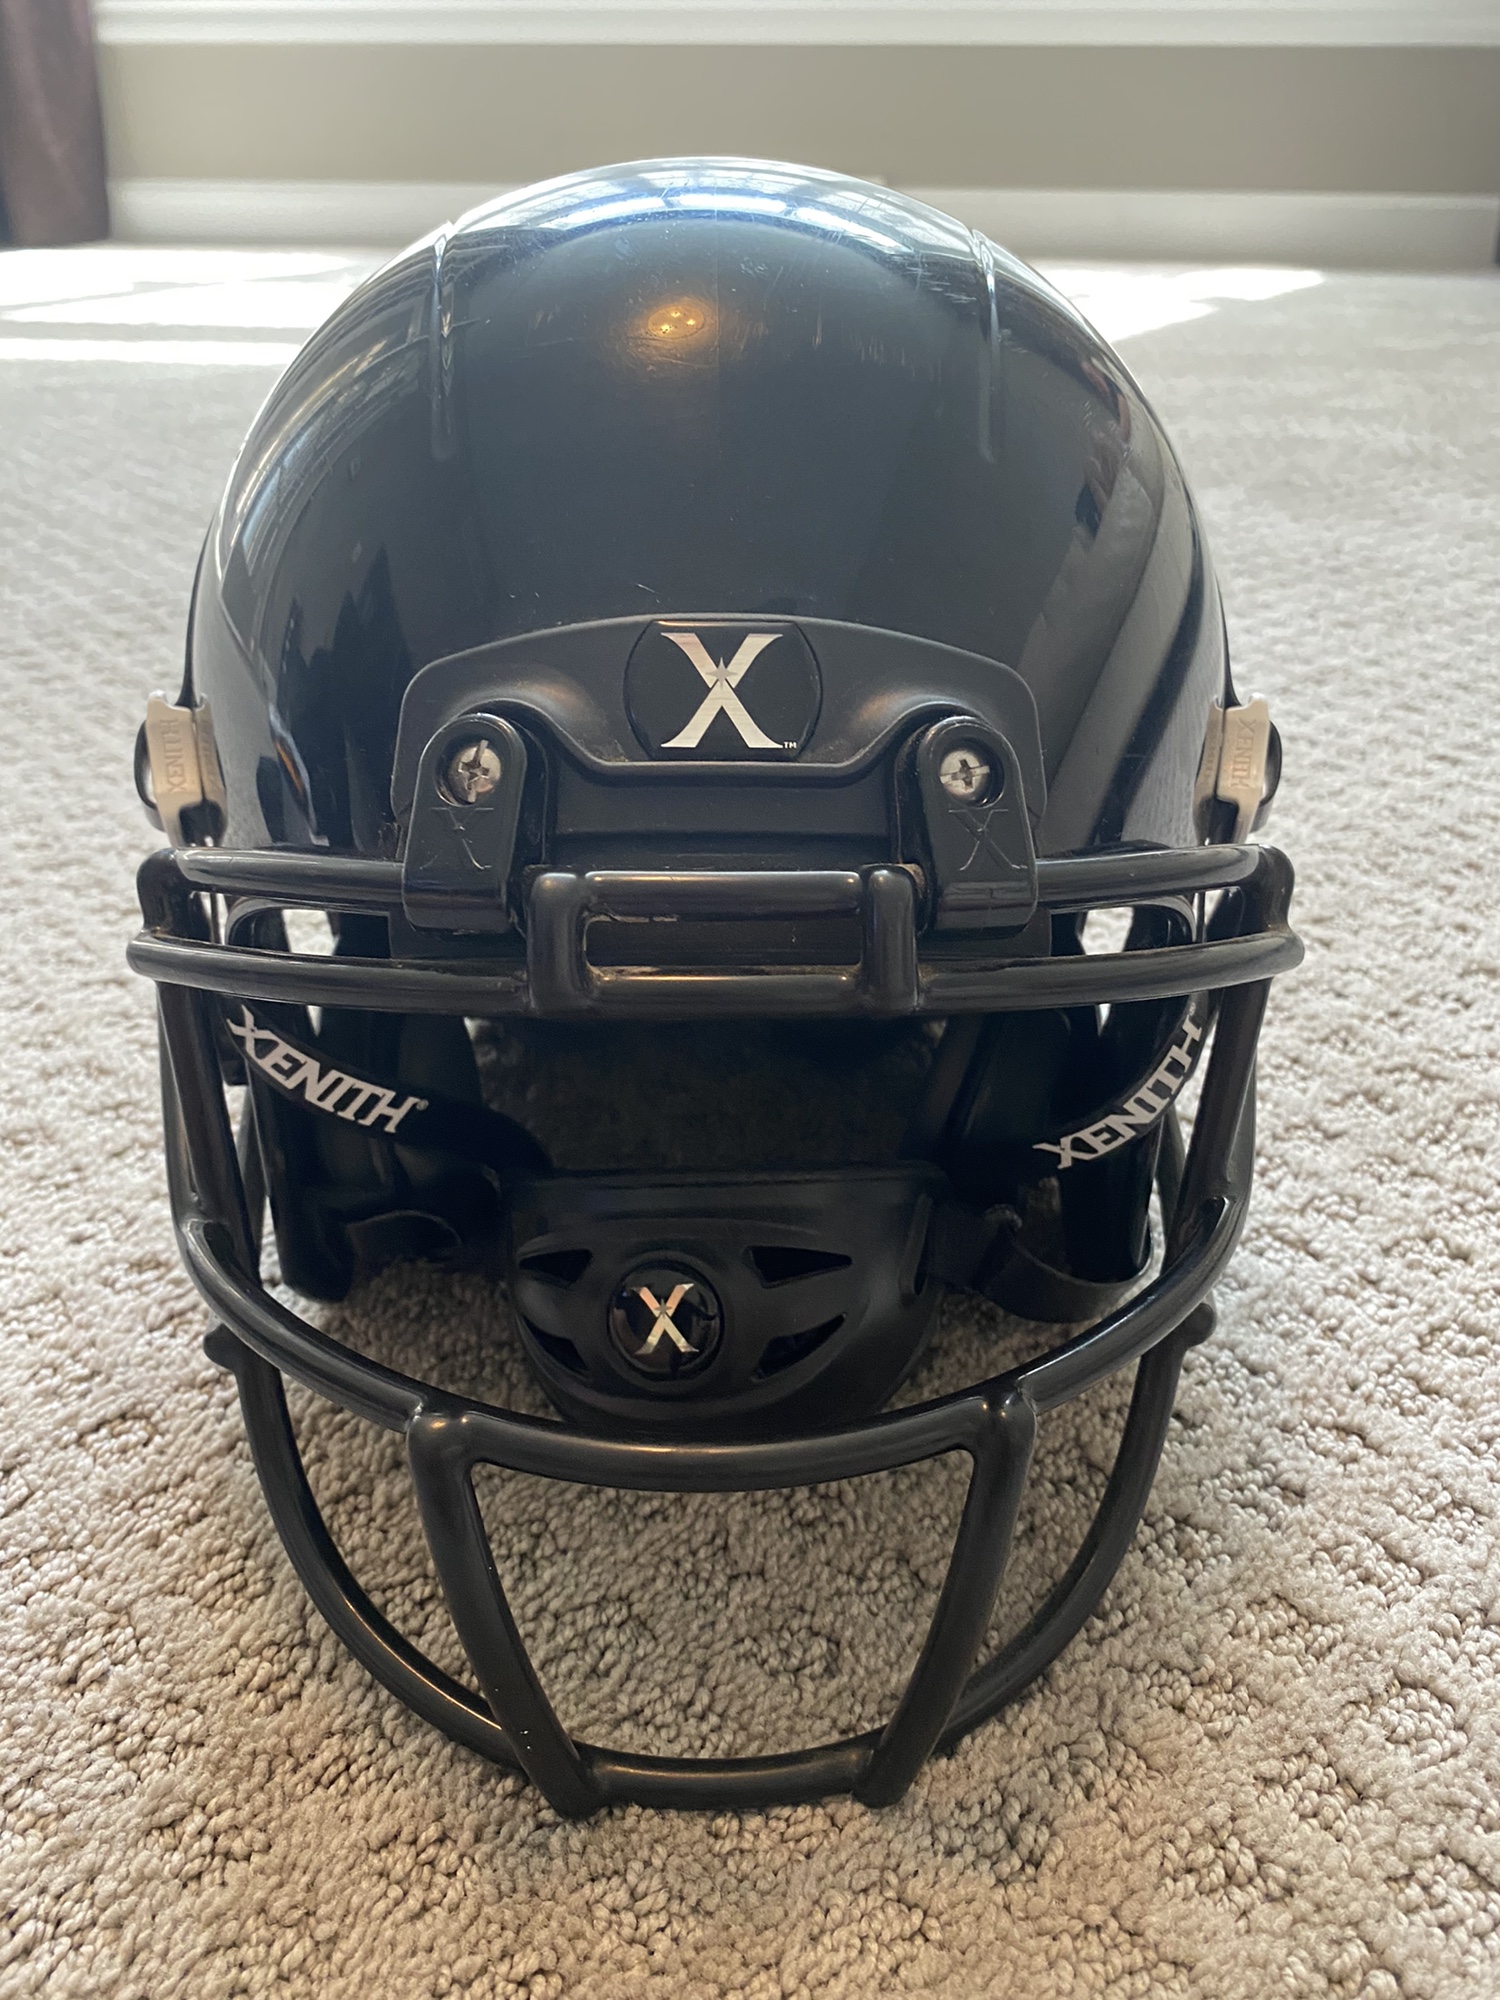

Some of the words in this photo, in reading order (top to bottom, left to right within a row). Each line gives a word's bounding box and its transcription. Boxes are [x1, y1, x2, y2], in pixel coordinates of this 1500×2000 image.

[660, 632, 784, 749] X
[159, 718, 187, 793] XENITH
[1230, 717, 1257, 789] XENITH
[630, 1283, 700, 1355] X
